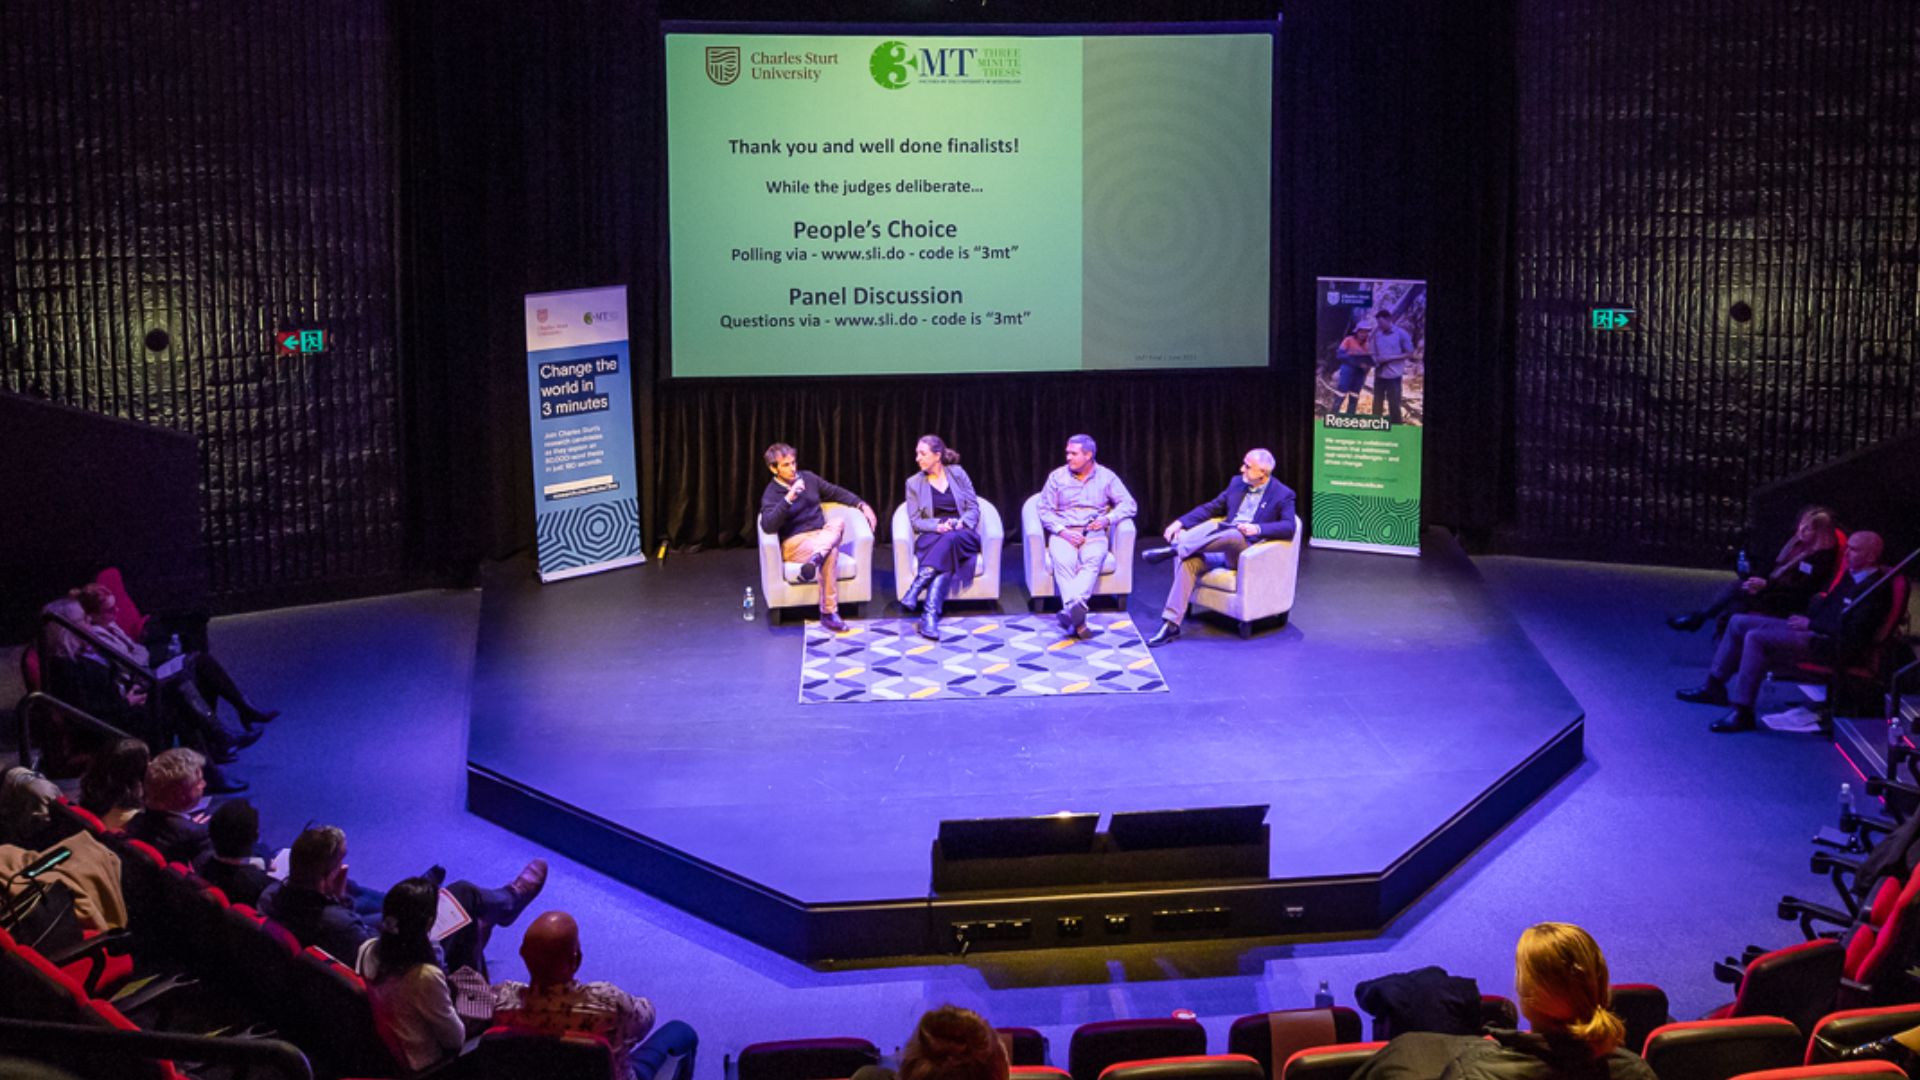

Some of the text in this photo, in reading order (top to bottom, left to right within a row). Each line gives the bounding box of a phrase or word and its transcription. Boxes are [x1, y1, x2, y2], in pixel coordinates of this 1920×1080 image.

[750, 51, 838, 66] Charles Sturt
[983, 48, 1021, 57] THREE
[978, 58, 1021, 67] MINUTE
[751, 67, 822, 82] University
[983, 68, 1021, 77] THESIS
[728, 137, 1019, 158] Thank you and well done finalists!
[765, 179, 810, 195] While
[813, 179, 839, 194] the
[841, 179, 892, 197] judges
[793, 219, 958, 243] People’s Choice
[731, 247, 782, 264] Polling
[786, 247, 808, 261] via
[821, 245, 906, 261] www.sli.do
[918, 245, 955, 260] code
[958, 245, 970, 260] is
[789, 286, 963, 306] Panel Discussion
[719, 313, 795, 329] Questions
[798, 313, 821, 328] via
[834, 312, 919, 327] www.sli.do
[931, 311, 967, 326] code
[970, 311, 982, 326] is
[540, 358, 617, 379] Change the
[541, 379, 593, 397] world in
[542, 397, 608, 416] 3 minutes
[1325, 414, 1389, 430] Research
